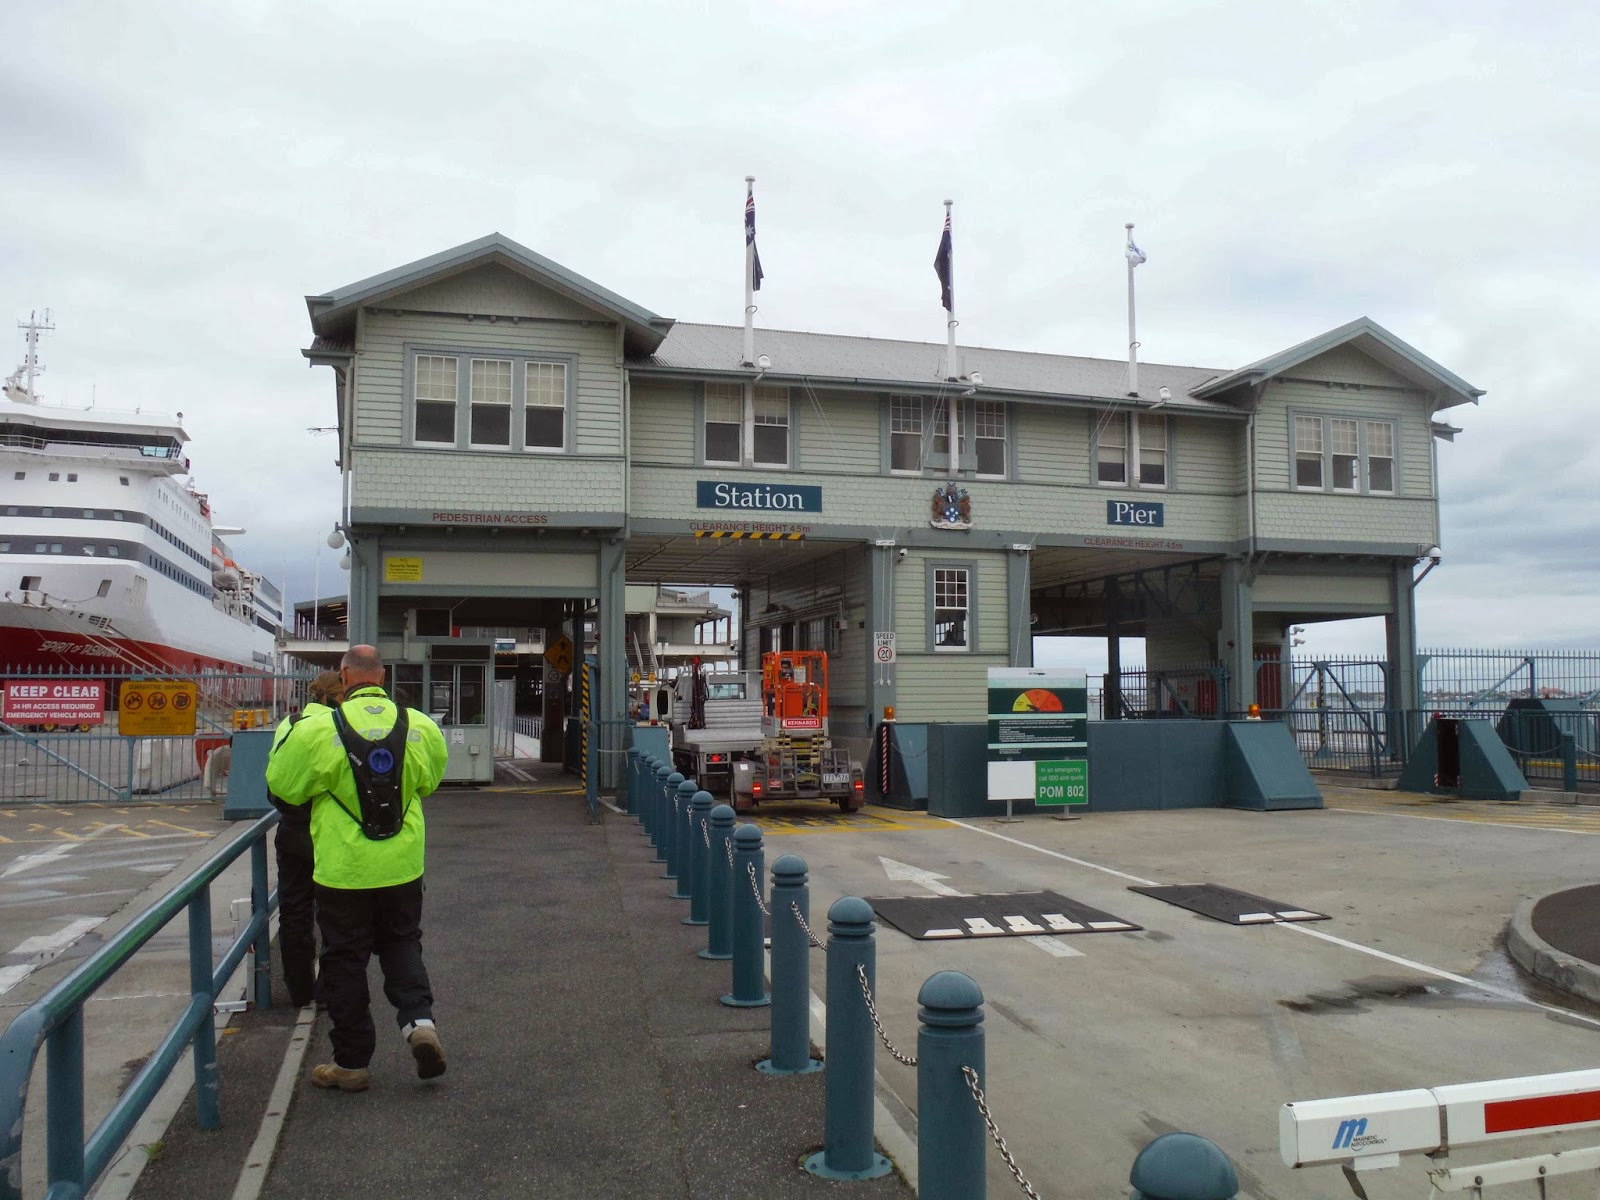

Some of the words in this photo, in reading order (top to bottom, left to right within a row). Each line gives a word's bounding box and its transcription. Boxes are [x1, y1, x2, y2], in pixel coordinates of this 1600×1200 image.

[714, 483, 805, 510] Station
[432, 512, 502, 523] PEDESTRIAN
[504, 514, 548, 524] ACCESS
[1114, 502, 1157, 525] Pier
[689, 522, 750, 532] CLEARANCE
[752, 523, 788, 533] HEIGHT
[1084, 538, 1134, 547] CLEARANCE
[1135, 541, 1164, 549] HEIGHT
[875, 632, 894, 640] SPEED
[37, 640, 75, 653] SPIRIT
[881, 649, 890, 659] 20
[10, 685, 48, 697] KEEP
[53, 685, 100, 697] CLEAR
[1040, 786, 1064, 798] POM
[1067, 785, 1084, 797] 802
